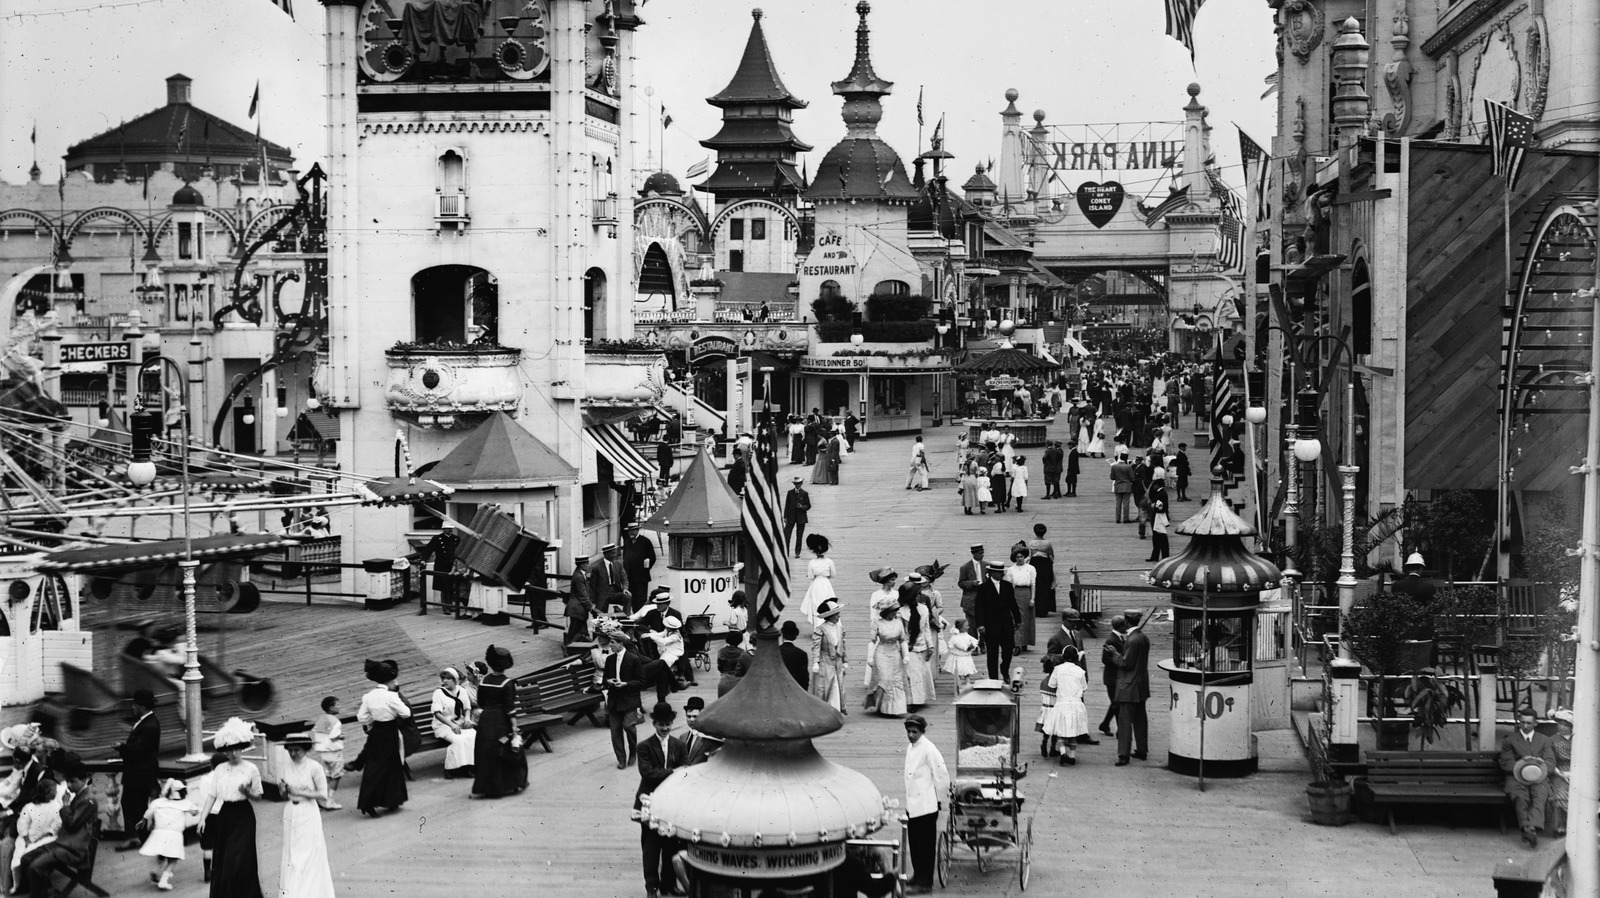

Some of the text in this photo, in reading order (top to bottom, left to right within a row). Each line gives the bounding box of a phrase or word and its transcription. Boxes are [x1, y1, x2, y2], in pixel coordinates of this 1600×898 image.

[803, 264, 856, 276] RESTAURANT
[60, 344, 128, 361] CHECKERS
[693, 340, 736, 356] RESTAURANT
[827, 359, 851, 367] DINNER
[766, 850, 819, 868] WITCHING
